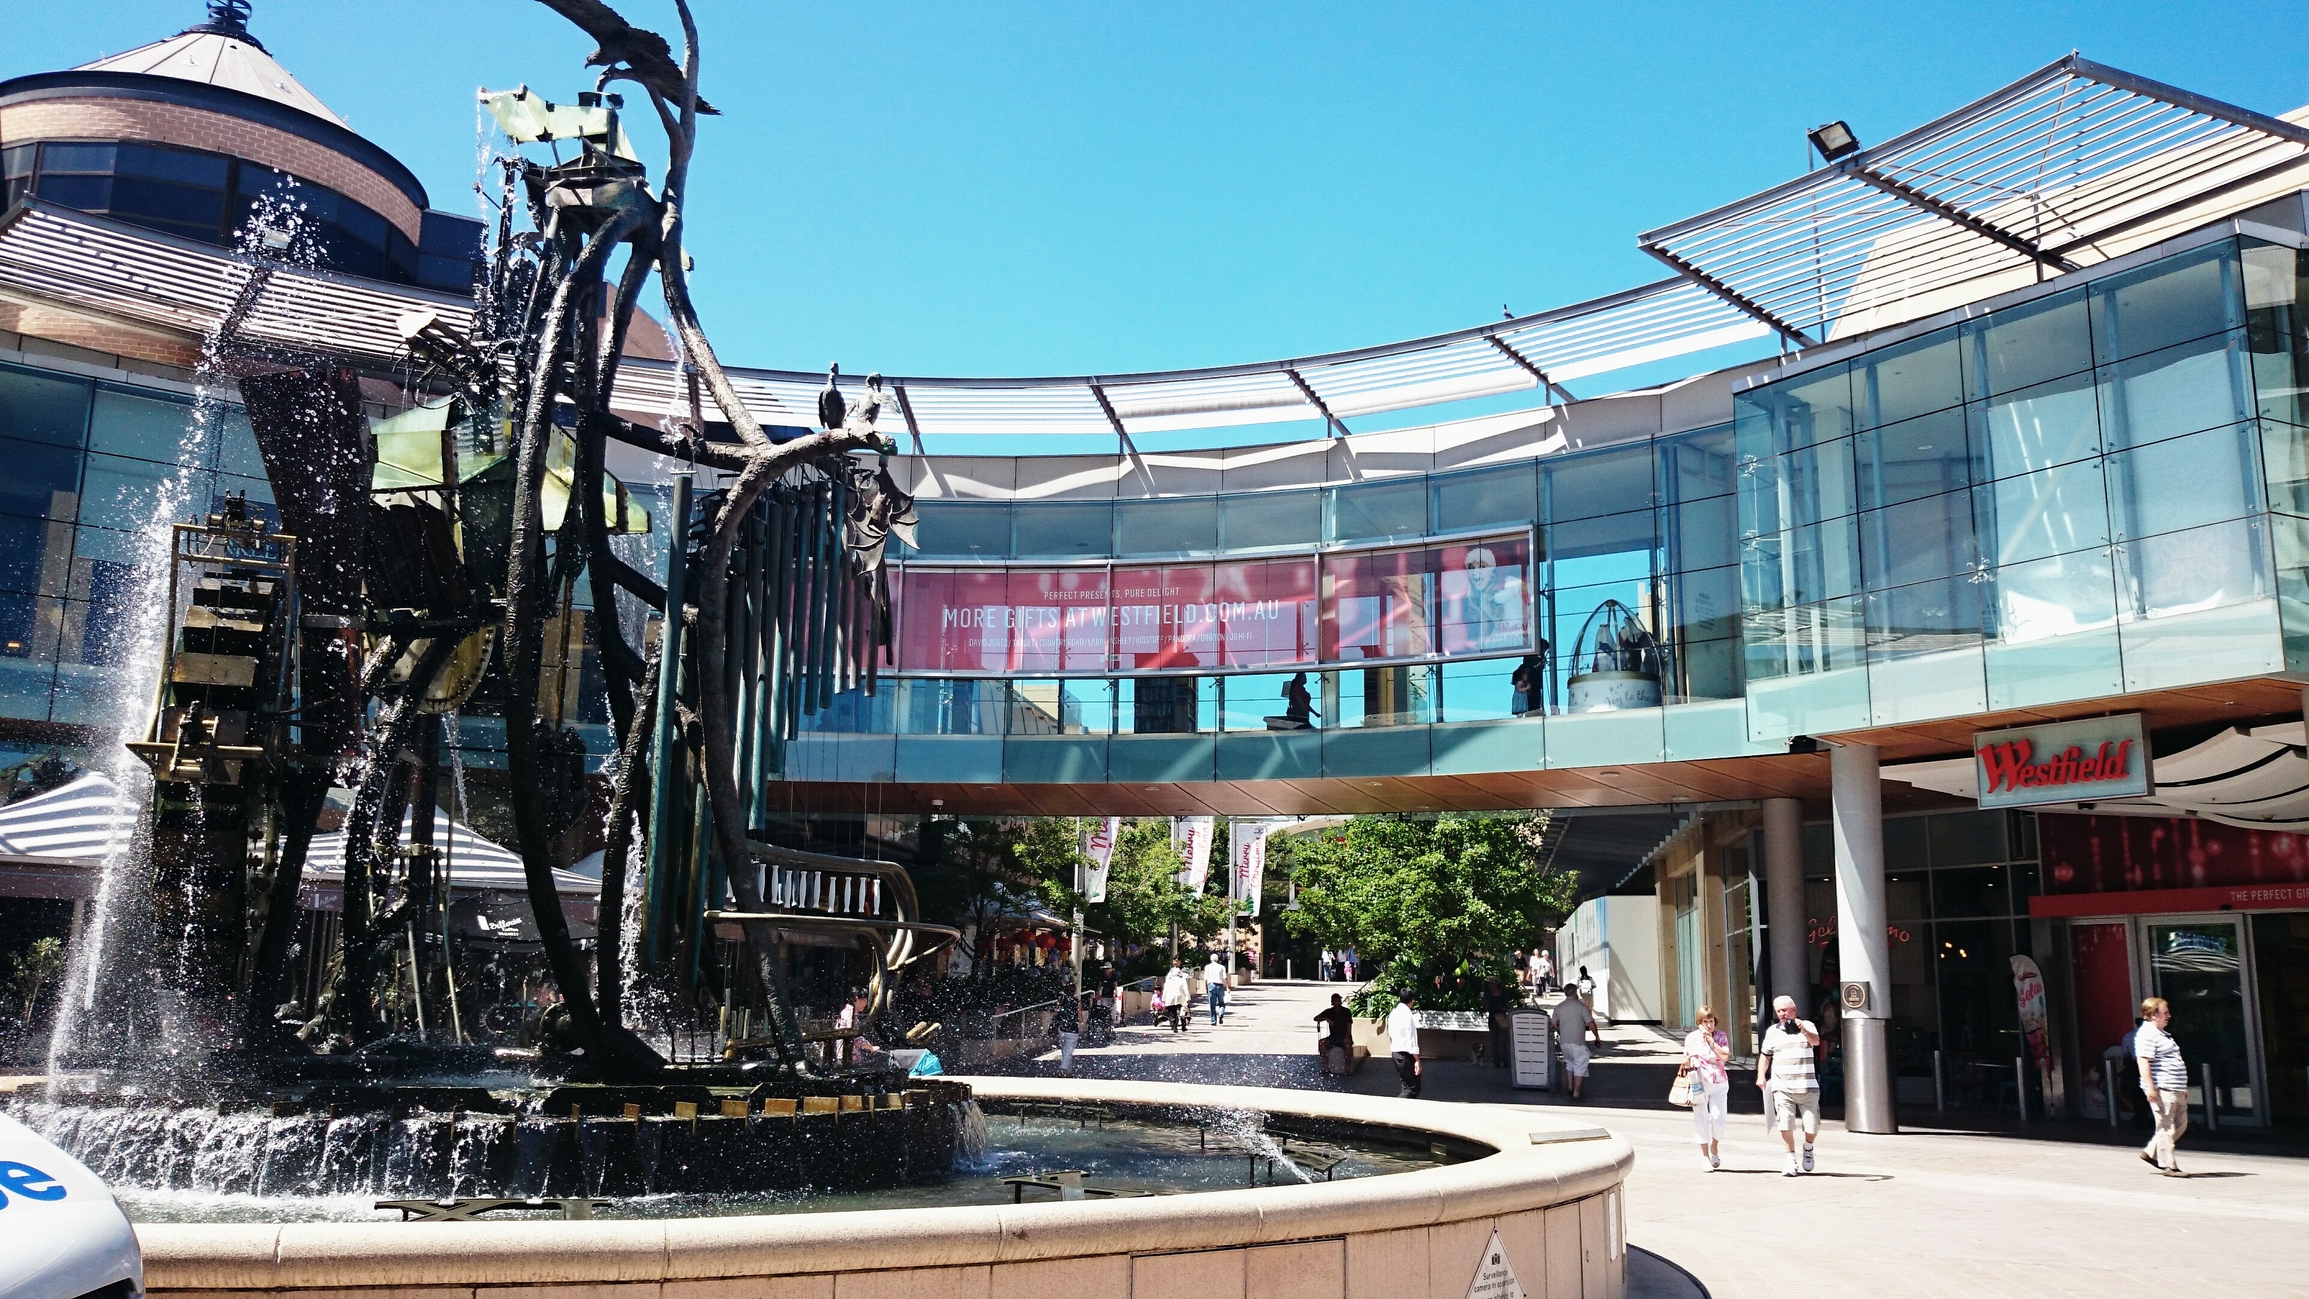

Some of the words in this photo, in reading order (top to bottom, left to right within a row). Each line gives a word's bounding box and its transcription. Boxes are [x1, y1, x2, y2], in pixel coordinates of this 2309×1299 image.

[1044, 591, 1077, 600] PERFECT
[1125, 588, 1144, 598] PURE
[1147, 586, 1180, 597] DELIGHT
[944, 608, 996, 628] MORE
[1005, 608, 1057, 628] GIFTS
[1065, 607, 1089, 628] AT
[1092, 600, 1279, 628] WESTFIELD.COM.AU
[969, 638, 987, 647] DAVID
[1067, 638, 1083, 646] ROAD
[1168, 634, 1196, 643] PANDORA
[1229, 632, 1238, 641] JB
[1239, 632, 1252, 641] HI-FI
[1976, 738, 2134, 794] Westfield
[2230, 891, 2248, 901] THE
[2251, 888, 2293, 901] PERFECT
[1474, 1284, 1491, 1293] camera
